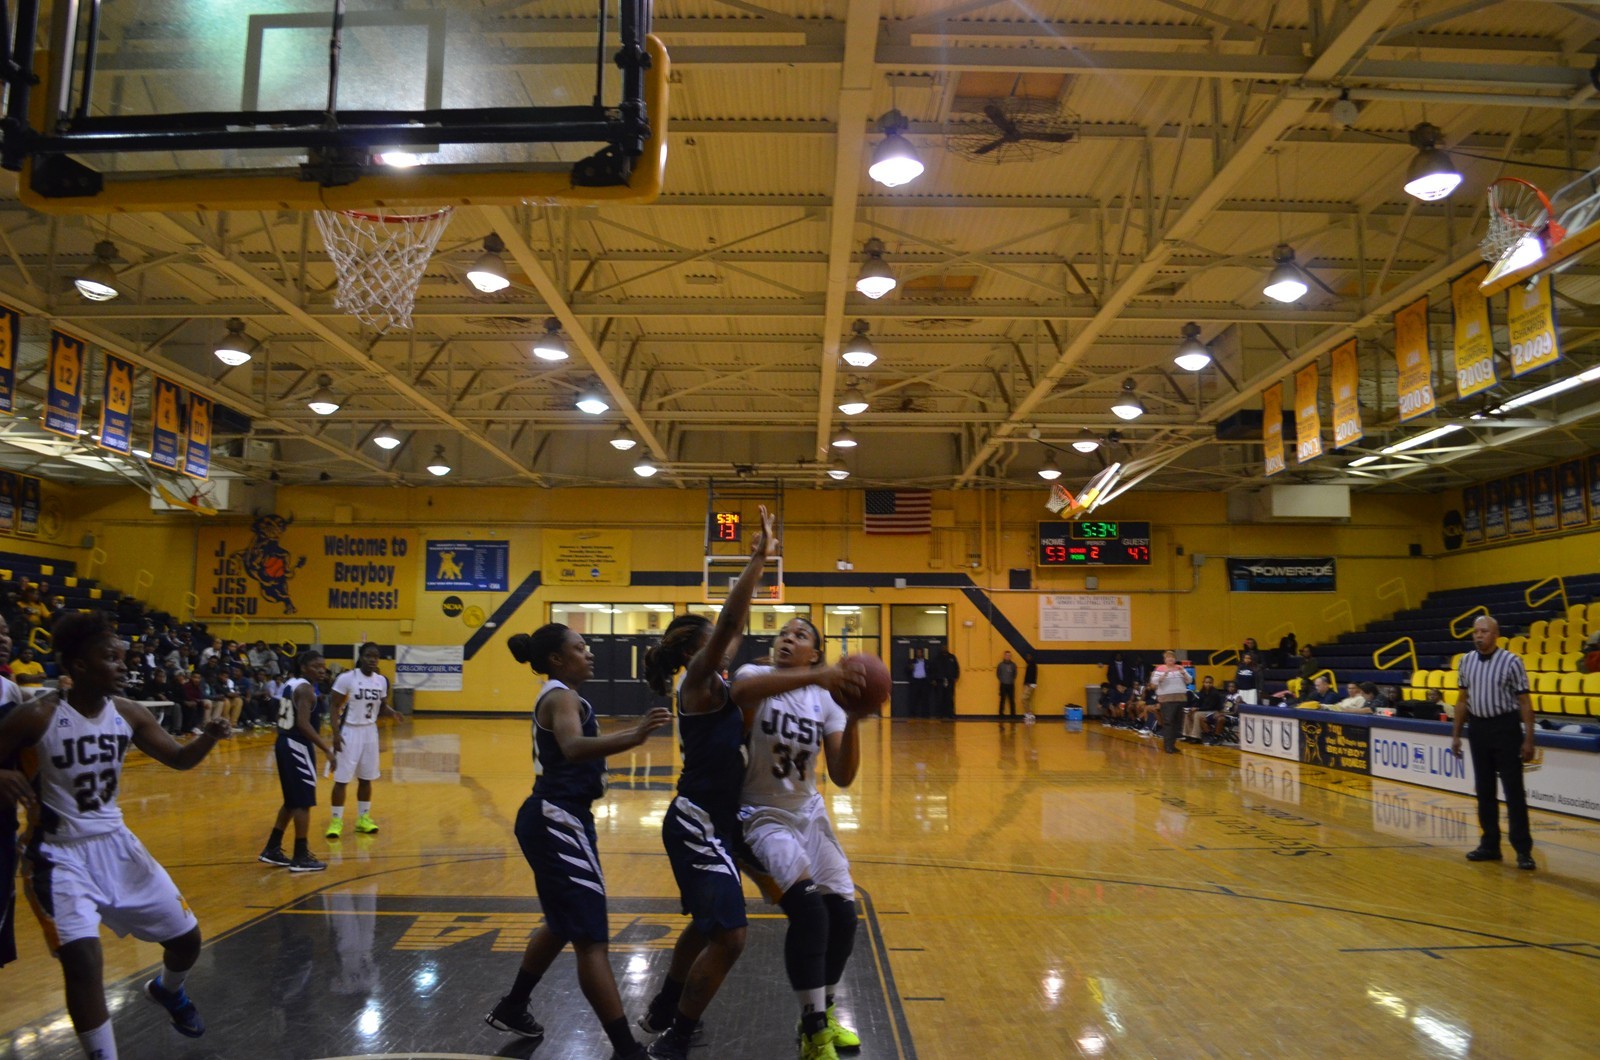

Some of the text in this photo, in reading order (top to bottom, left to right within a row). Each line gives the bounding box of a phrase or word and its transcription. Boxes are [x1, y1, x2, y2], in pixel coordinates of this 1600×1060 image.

[1511, 331, 1553, 366] 2009
[59, 365, 73, 385] 12
[1457, 358, 1492, 389] 2009
[1398, 385, 1431, 414] 2008
[717, 513, 739, 524] 5:34
[720, 523, 735, 540] 13
[1081, 522, 1117, 538] 5:34
[215, 540, 226, 557] J
[324, 534, 408, 557] Welcome to
[1041, 538, 1066, 546] HOME
[1121, 538, 1150, 546] GUEST
[1045, 546, 1066, 562] 53
[1090, 546, 1100, 559] 2
[1127, 546, 1149, 560] 47
[335, 561, 396, 586] Brayboy
[1252, 565, 1334, 576] POWERADE
[213, 577, 247, 595] JCS
[211, 596, 258, 615] JCSU
[328, 587, 399, 610] Madness!
[397, 664, 427, 673] GREGORY
[365, 702, 374, 719] 3
[772, 743, 813, 781] 34
[1374, 739, 1409, 769] FOOD
[1430, 746, 1466, 779] LION
[73, 768, 118, 813] 23
[1531, 789, 1557, 803] Alumni
